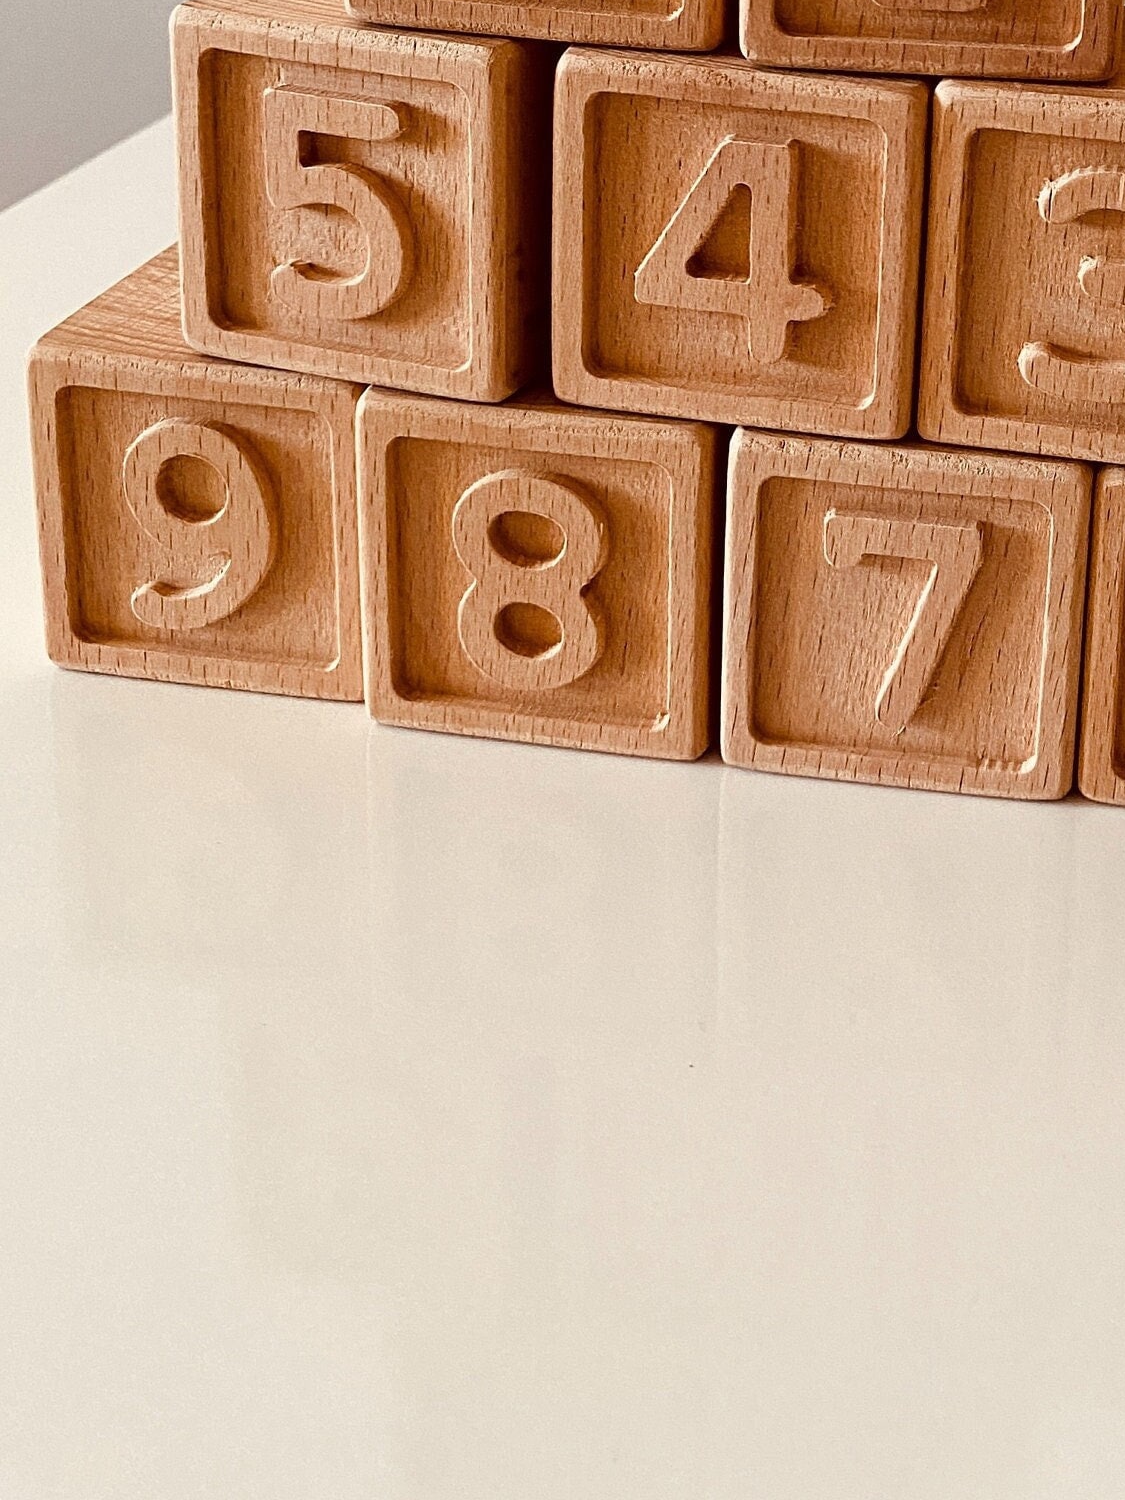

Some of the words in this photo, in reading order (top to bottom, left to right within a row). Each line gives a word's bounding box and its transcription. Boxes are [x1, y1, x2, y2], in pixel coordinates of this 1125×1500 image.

[264, 83, 411, 321] 5
[633, 134, 834, 364] 4
[122, 416, 271, 630] 9
[451, 467, 603, 690] 8
[823, 507, 982, 736] 7
